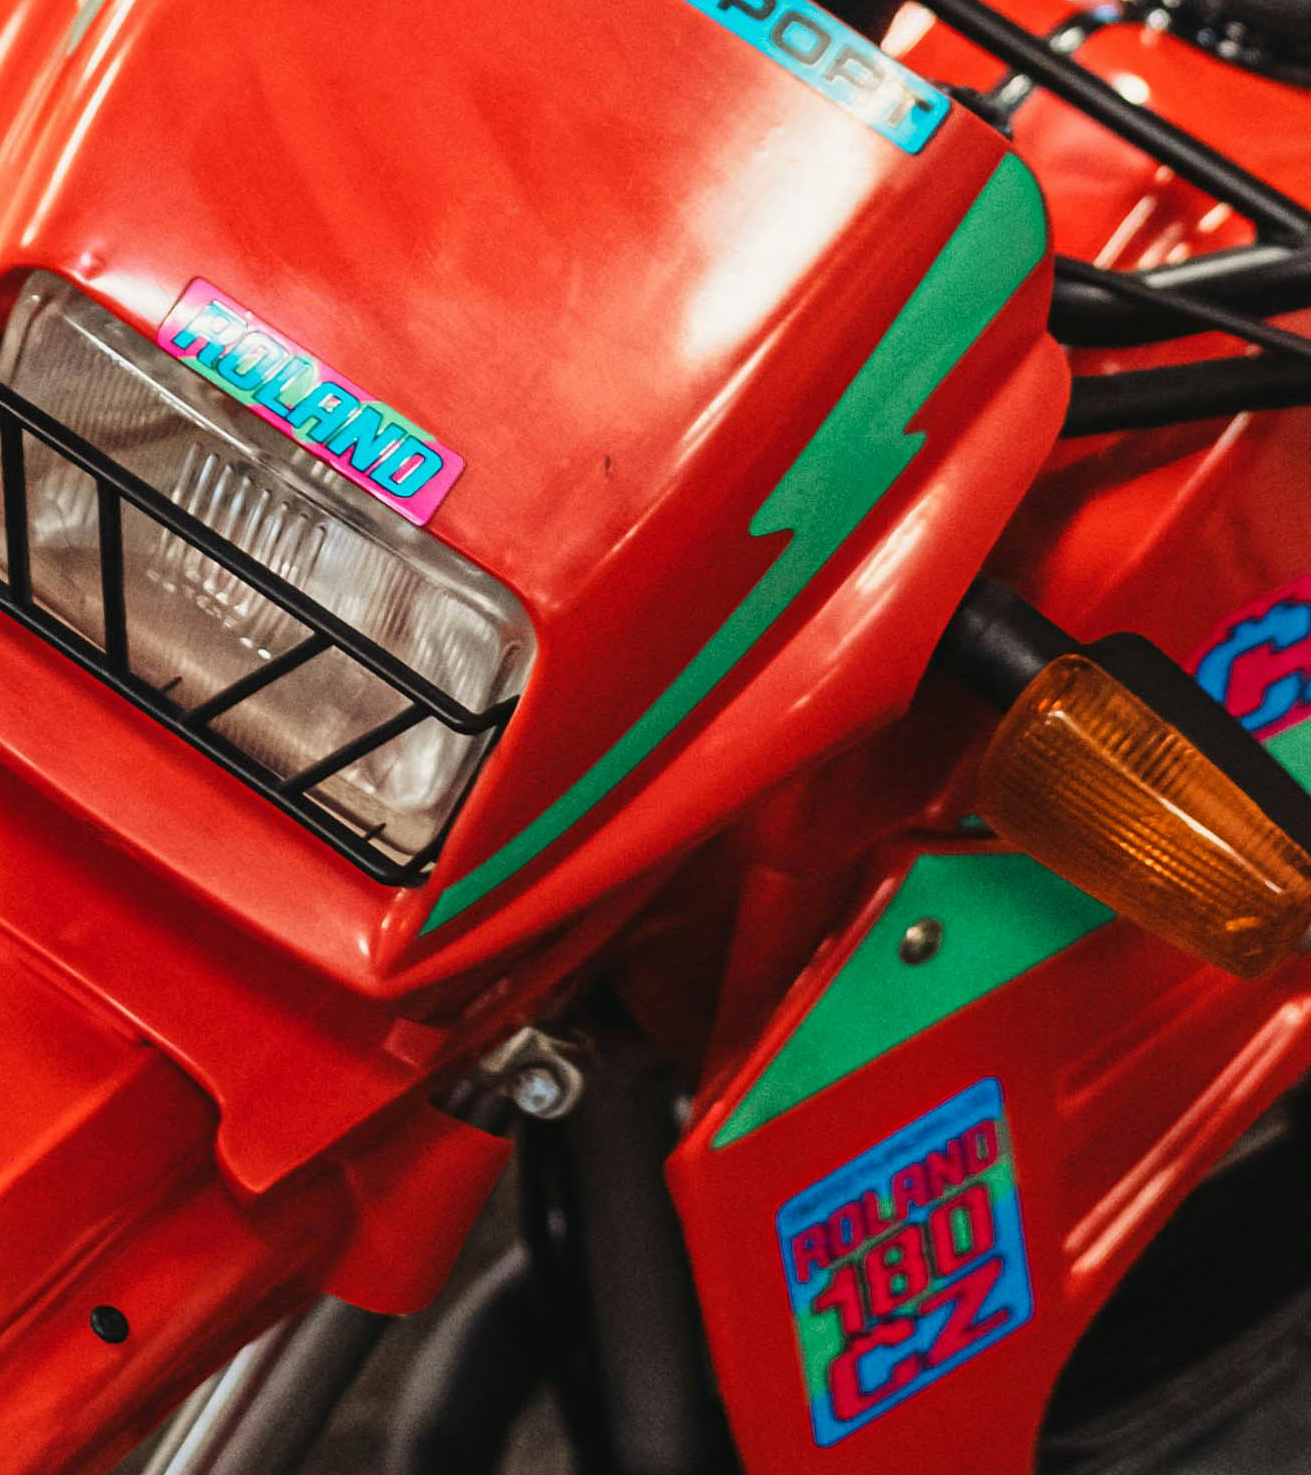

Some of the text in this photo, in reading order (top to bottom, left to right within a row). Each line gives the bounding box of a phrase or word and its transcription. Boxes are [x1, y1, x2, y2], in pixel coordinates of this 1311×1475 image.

[171, 300, 444, 498] ROLAND
[792, 1119, 998, 1283] ROLAND
[813, 1184, 995, 1336] 180
